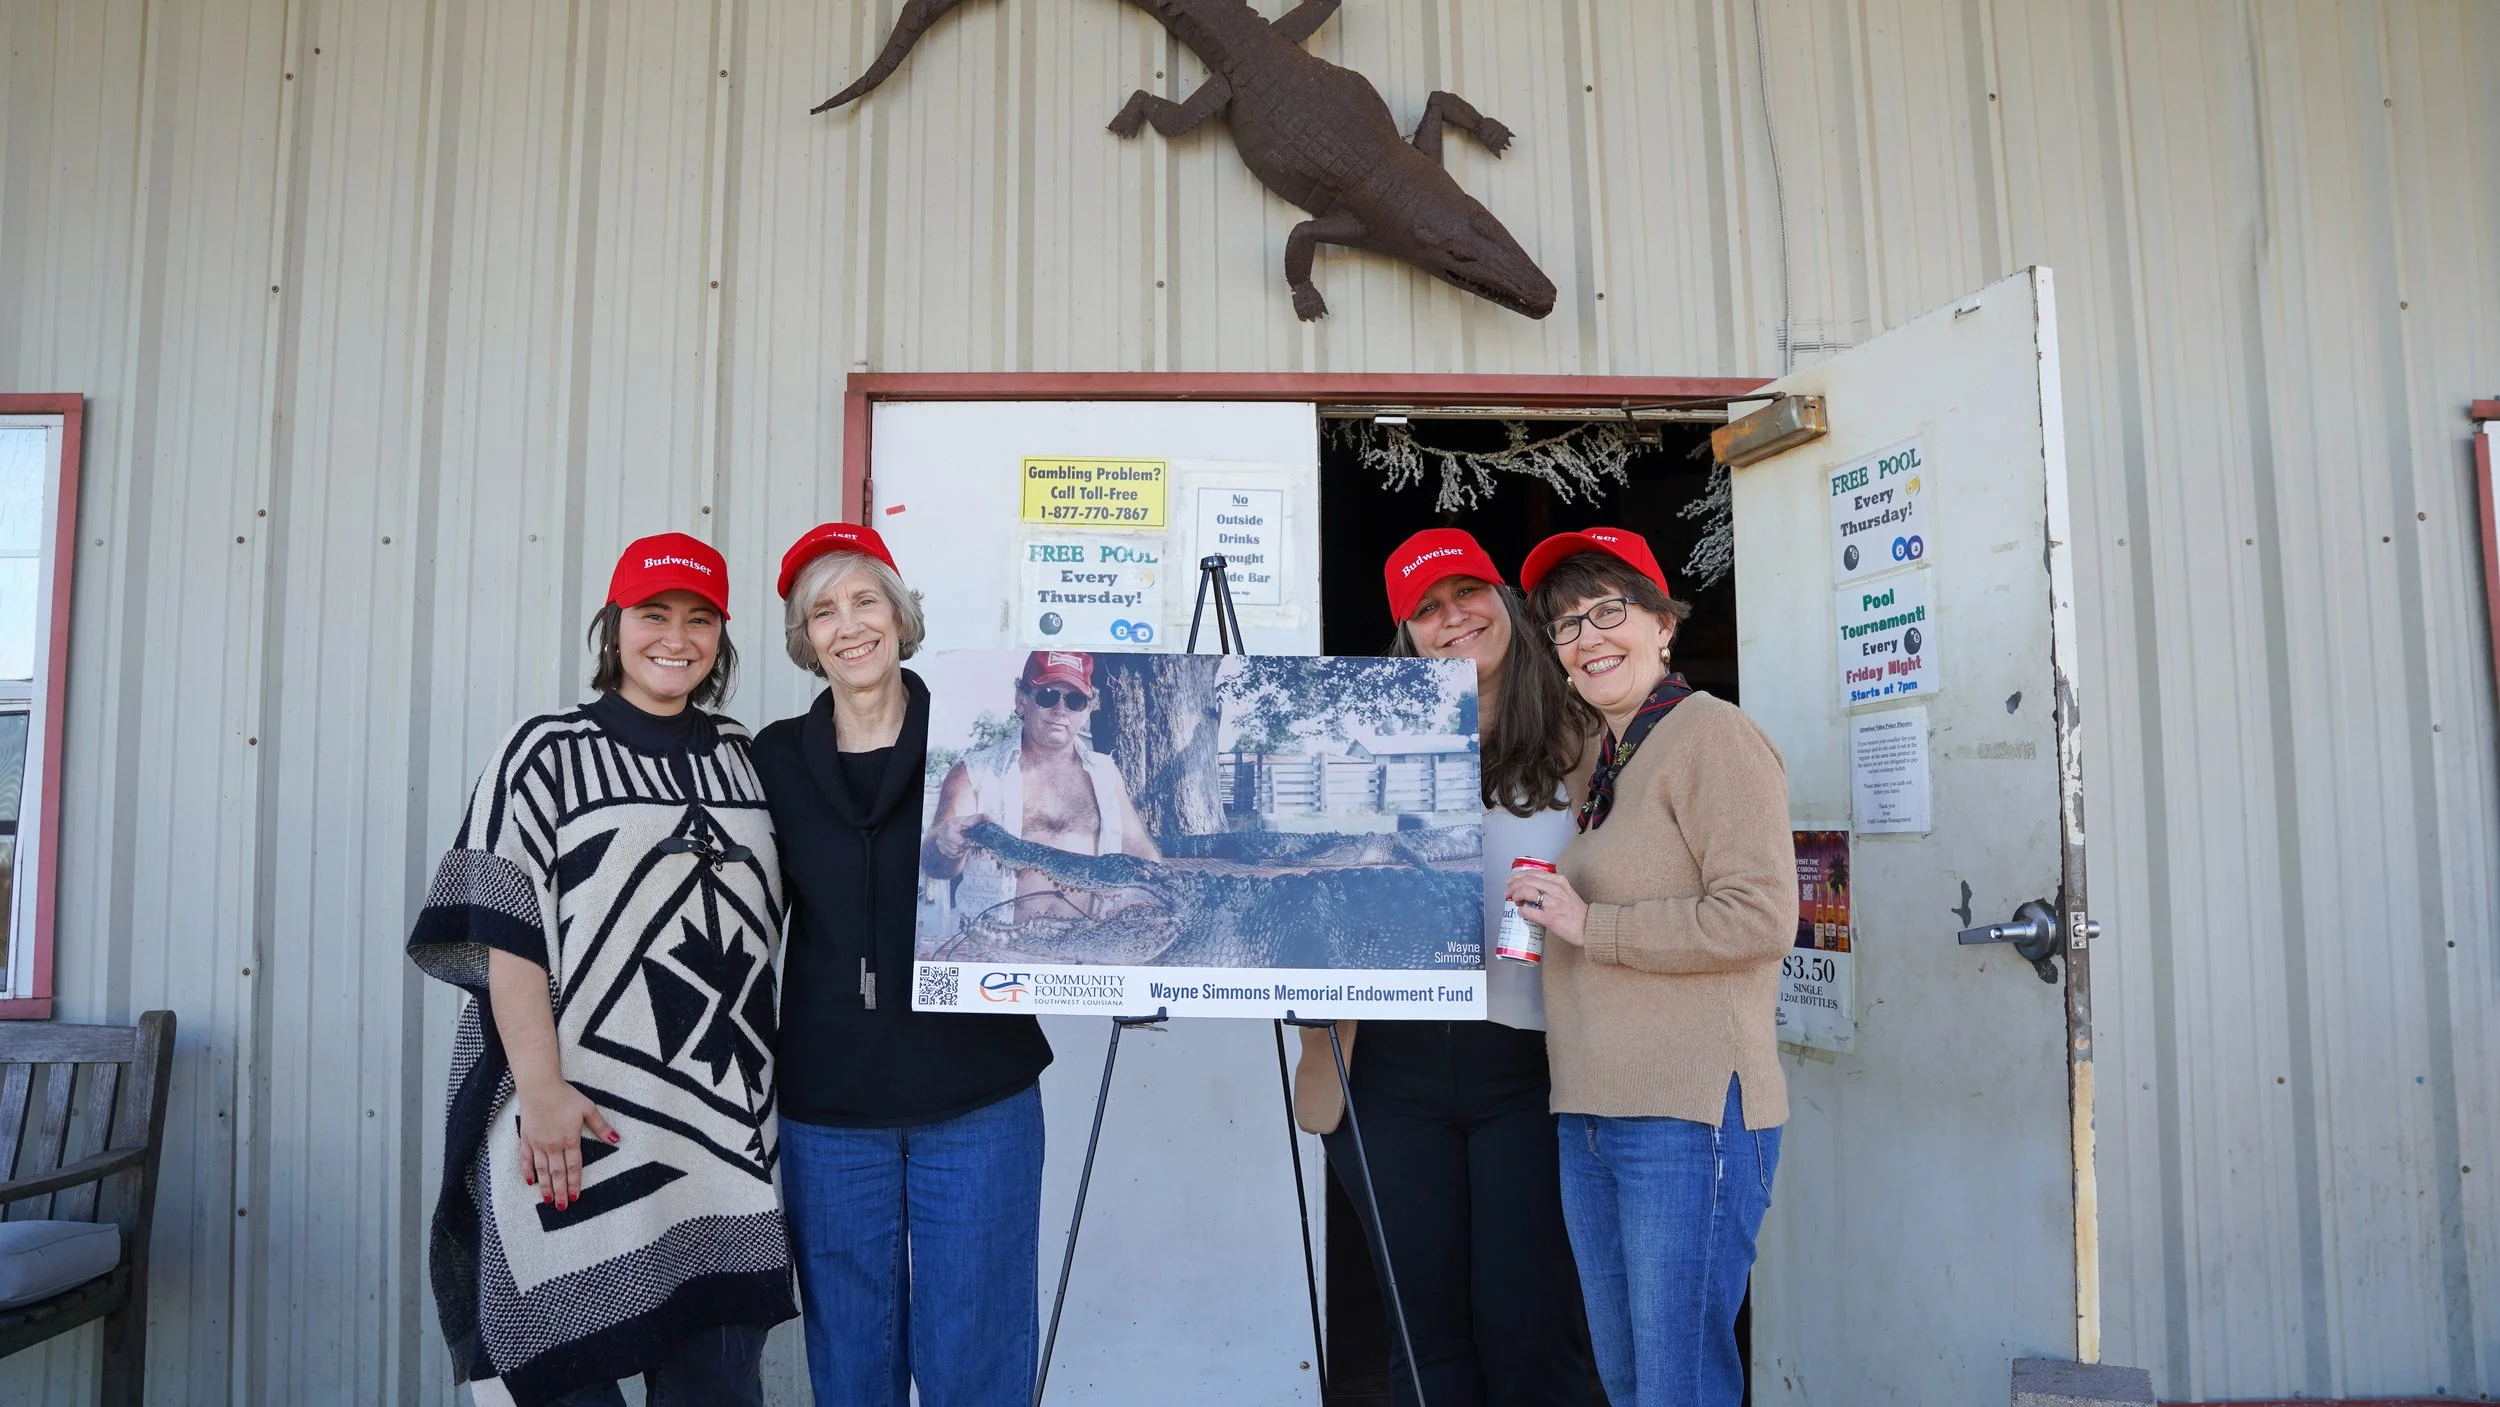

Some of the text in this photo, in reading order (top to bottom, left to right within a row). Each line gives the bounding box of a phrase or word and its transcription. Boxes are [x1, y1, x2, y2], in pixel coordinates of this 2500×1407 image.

[1028, 465, 1161, 482] Gambling Problem?
[1831, 448, 1921, 496] FREE POOL
[1050, 486, 1138, 500] Call Toll-Free
[1232, 494, 1248, 505] No
[1854, 488, 1893, 511] Every
[1040, 506, 1149, 520] 1-877-770-7867
[1216, 513, 1263, 525] Outside
[1840, 501, 1912, 537] Thursday!
[1218, 533, 1260, 544] Drinks
[1028, 544, 1159, 563] FREE POOL
[1214, 552, 1264, 565] rought
[1401, 546, 1464, 578] Budweiser
[644, 555, 712, 576] Budweiser
[1060, 569, 1118, 586] Every
[1248, 572, 1271, 583] Bar
[1037, 590, 1142, 607] Thursday!
[1862, 588, 1895, 611] Pool
[1840, 605, 1926, 640] Tournament!
[1862, 639, 1898, 656] Every
[1845, 655, 1922, 684] Friday Night
[1851, 681, 1918, 701] Starts at 7pm
[1447, 941, 1481, 955] Wayne
[1434, 952, 1481, 964] Simmons
[1782, 955, 1835, 983] $3.50
[1034, 973, 1126, 986] COMMUNITY
[1034, 986, 1124, 998] FOUNDATION
[1150, 982, 1473, 1002] Wayne Simmons Memorial Endowment Fund
[1793, 983, 1823, 996] SINGLE
[1800, 994, 1838, 1010] BOTTLES
